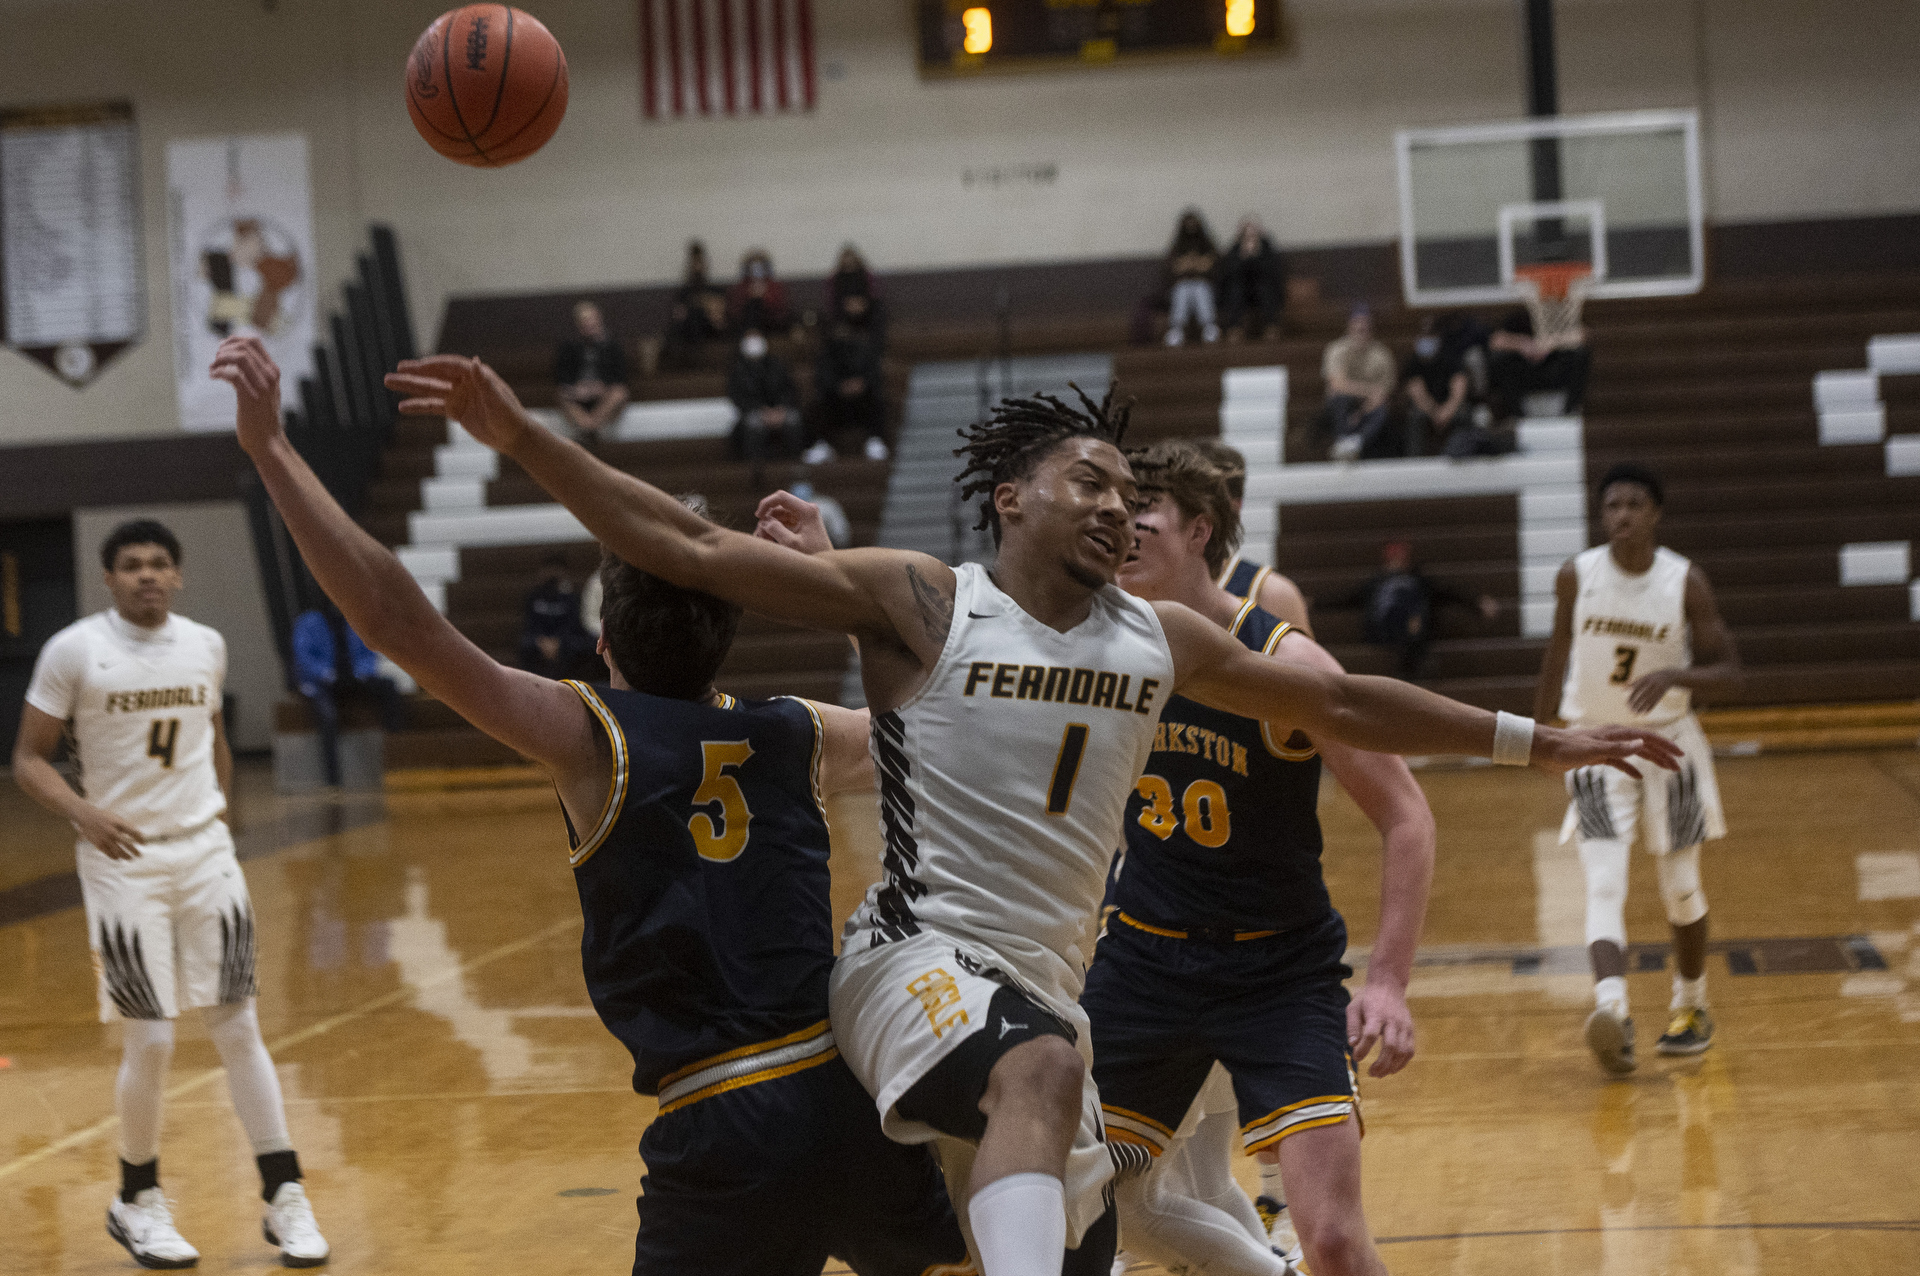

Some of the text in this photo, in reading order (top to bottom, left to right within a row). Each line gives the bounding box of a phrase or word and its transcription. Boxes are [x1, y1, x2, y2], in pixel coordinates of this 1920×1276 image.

[964, 662, 1160, 715] FERNDALE
[1609, 646, 1638, 687] 3
[147, 718, 180, 770] 4
[1045, 722, 1091, 816] 1
[688, 738, 756, 863] 5
[1136, 773, 1232, 848] 30
